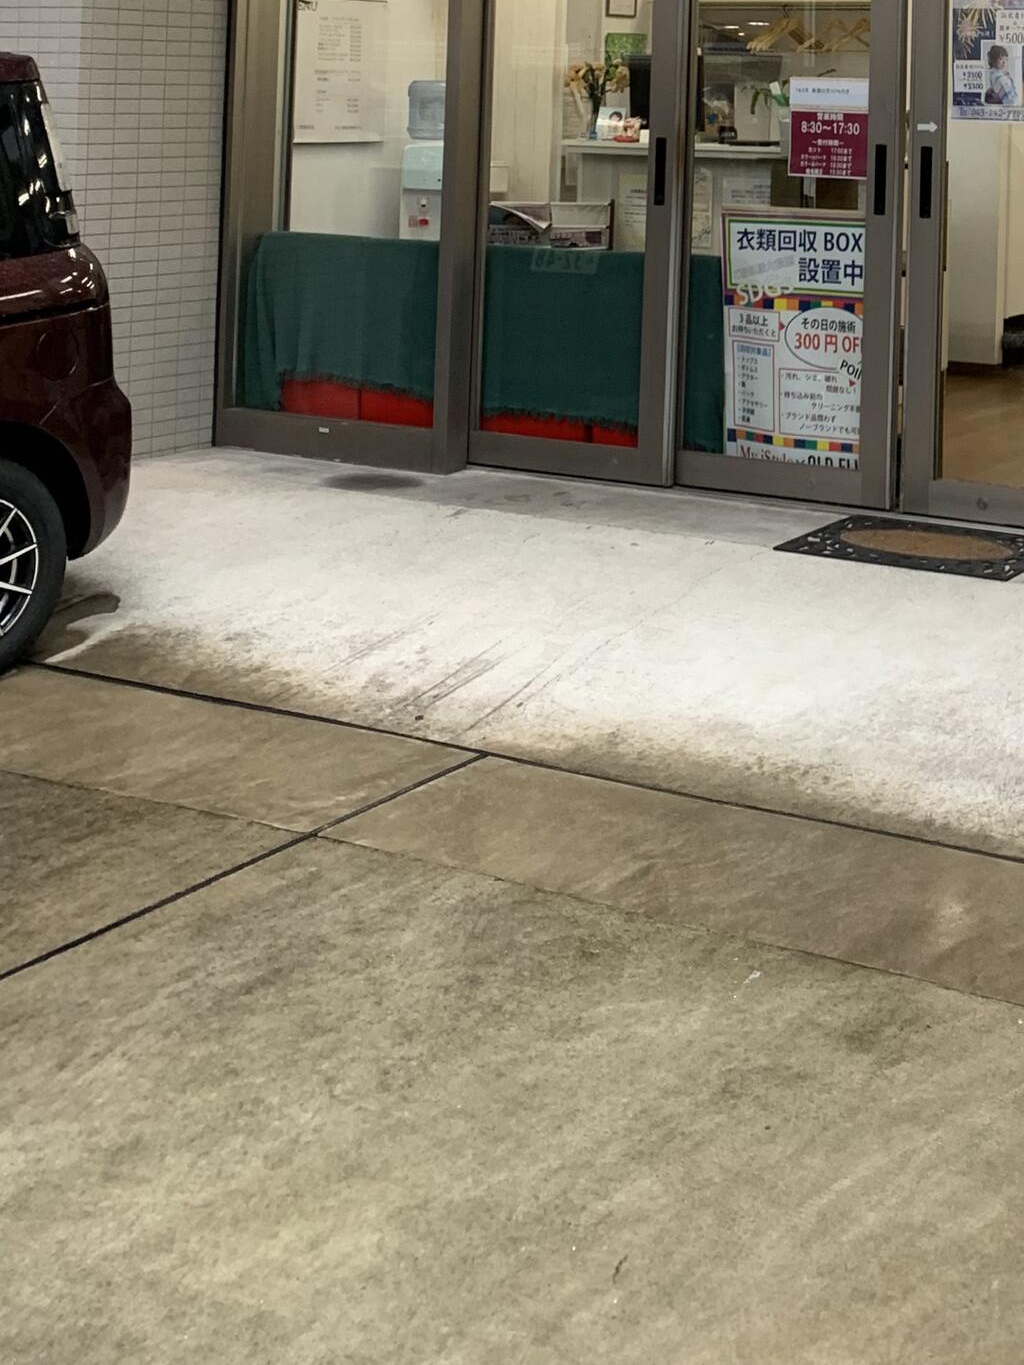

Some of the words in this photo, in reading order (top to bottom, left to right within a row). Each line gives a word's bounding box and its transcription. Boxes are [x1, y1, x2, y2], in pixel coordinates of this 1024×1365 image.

[297, 0, 318, 11] ENU
[737, 228, 817, 252] 衣類回収
[824, 233, 863, 252] BOX
[798, 257, 863, 286] 設置中
[801, 318, 856, 333] その日の施術
